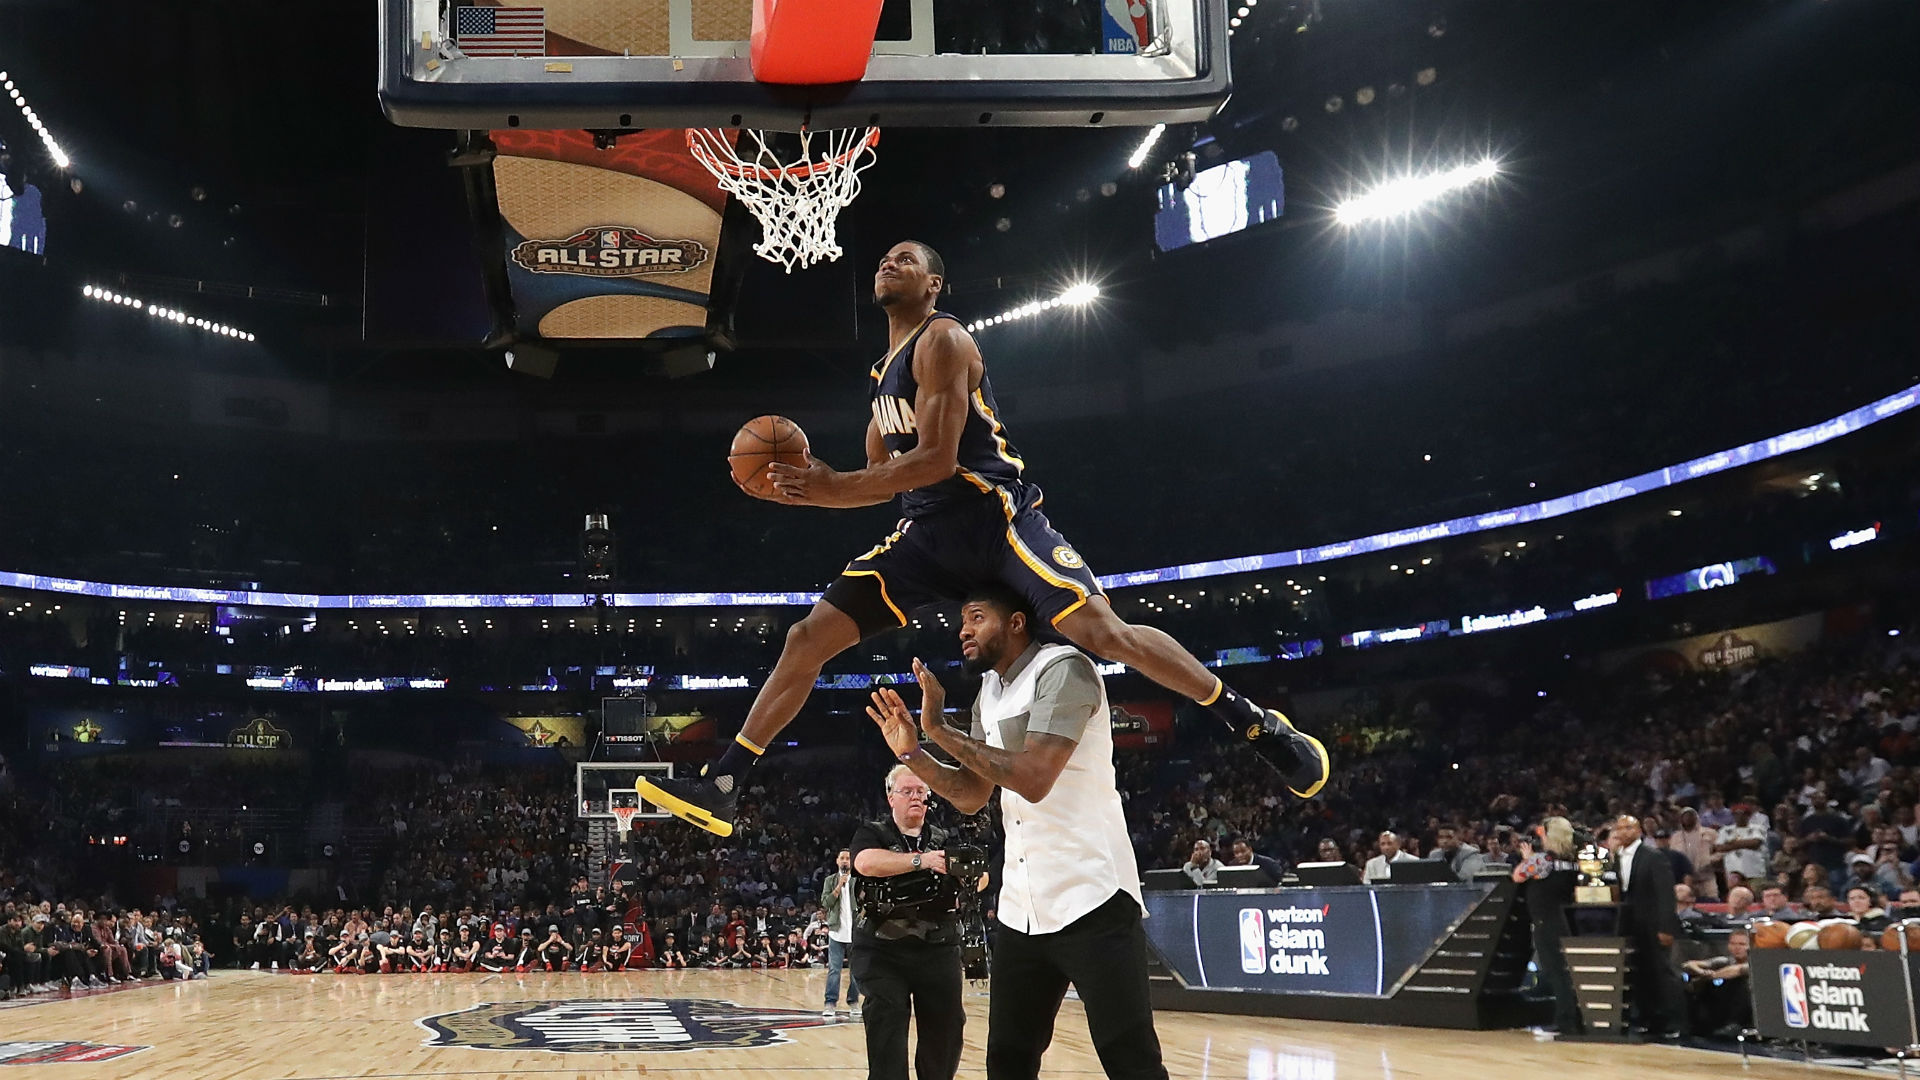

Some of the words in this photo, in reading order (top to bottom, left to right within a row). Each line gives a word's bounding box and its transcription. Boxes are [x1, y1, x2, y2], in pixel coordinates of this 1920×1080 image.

[1108, 38, 1134, 51] NBA
[537, 248, 596, 267] ALL
[599, 248, 682, 268] STAR
[353, 678, 385, 691] dunk
[1267, 905, 1324, 923] verizon
[1268, 923, 1325, 949] slam
[1269, 949, 1330, 975] dunk
[1806, 963, 1862, 981] verizon
[1808, 980, 1864, 1007] slam
[1811, 1004, 1871, 1032] dunk
